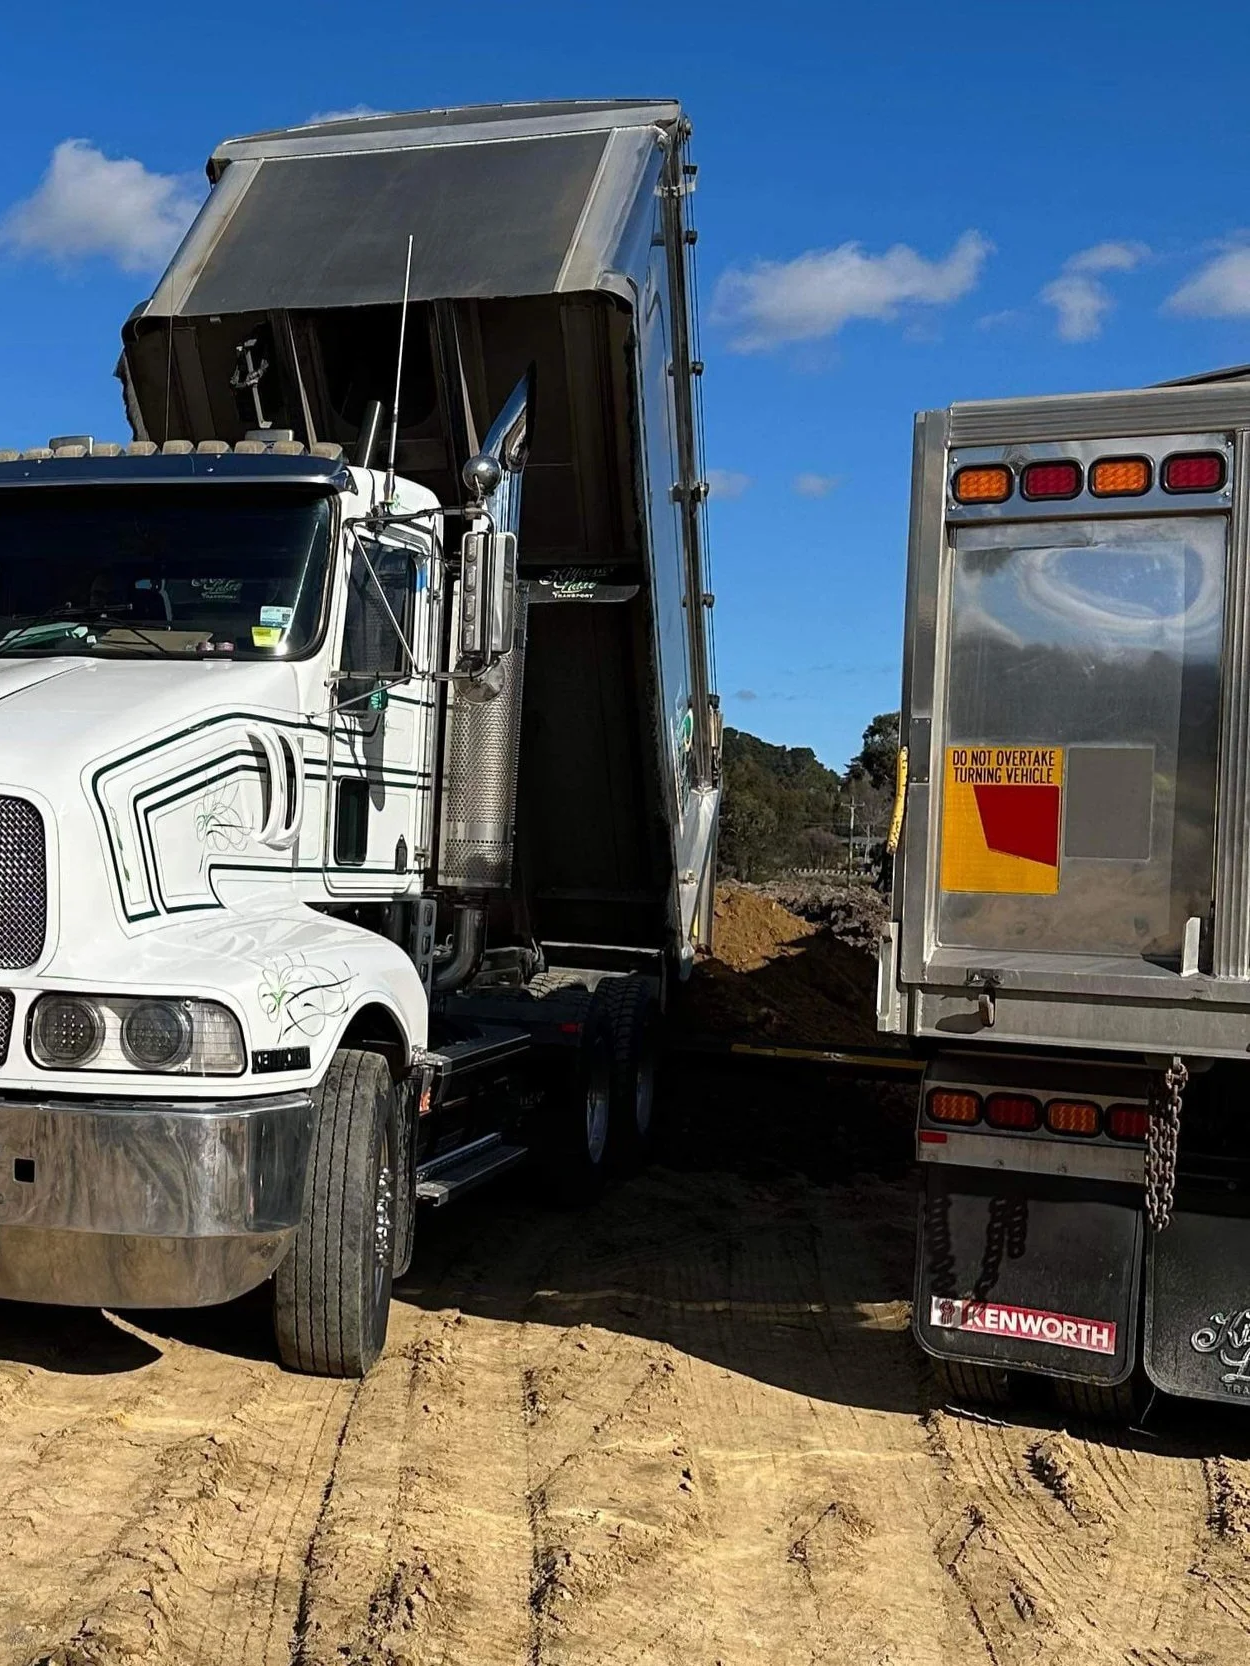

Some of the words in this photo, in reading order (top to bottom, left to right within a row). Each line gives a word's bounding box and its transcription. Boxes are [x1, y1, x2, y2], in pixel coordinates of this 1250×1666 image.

[952, 750, 968, 766] DO
[971, 750, 993, 766] NOT
[996, 750, 1055, 767] OVERTAKE
[954, 767, 1002, 784] TURNING
[1006, 768, 1054, 784] VEHICLE
[966, 1306, 1109, 1348] KENWORTH
